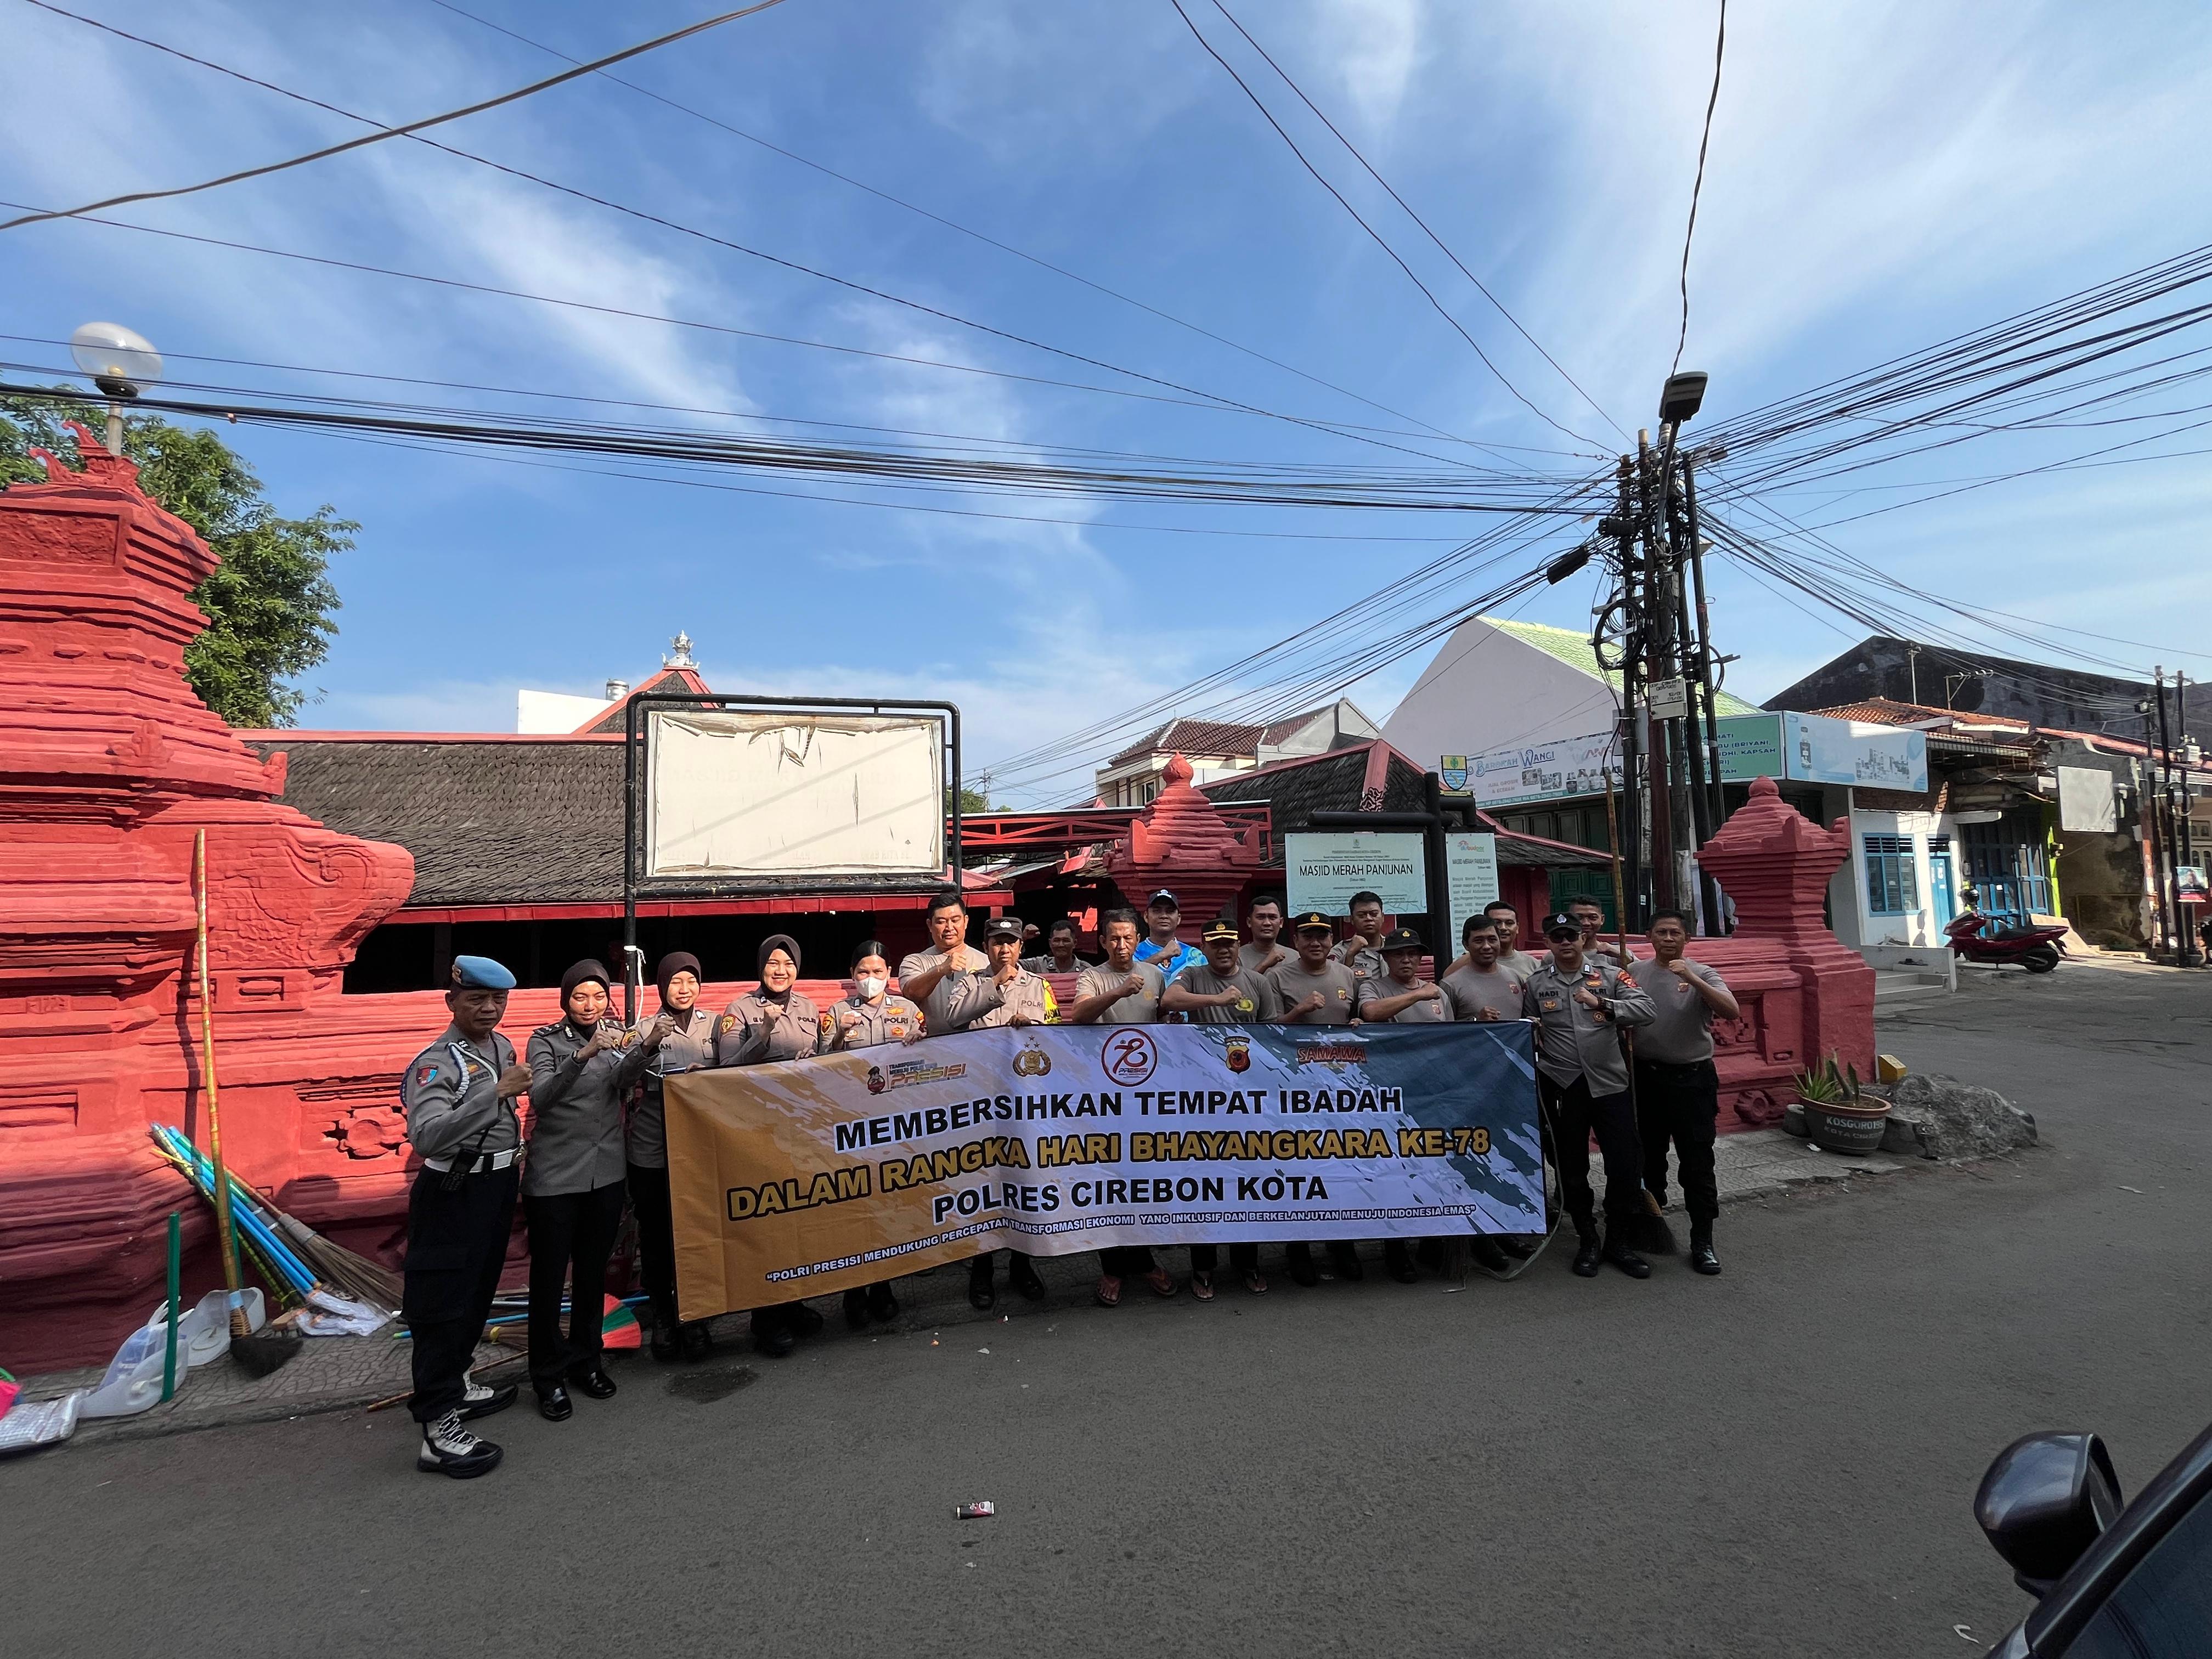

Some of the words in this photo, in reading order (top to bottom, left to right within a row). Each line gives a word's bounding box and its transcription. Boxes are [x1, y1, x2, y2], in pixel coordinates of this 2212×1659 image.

[1518, 749, 1555, 768] WANGI
[1300, 865, 1330, 877] MASJID
[1333, 865, 1364, 876] MERAH
[1367, 864, 1413, 875] PANJUNAN
[1021, 1000, 1043, 1008] POLRI
[1297, 1045, 1366, 1063] SAMAWA
[890, 1063, 966, 1086] PRESISI
[835, 1092, 1122, 1150] MEMBERSIHKAN
[1135, 1090, 1267, 1115] TEMPAT
[1280, 1088, 1402, 1114] IBADAH
[1824, 1126, 1850, 1138] KOTA
[730, 1167, 870, 1218] DALAM
[882, 1138, 1029, 1193] RANGKA
[1039, 1133, 1120, 1167] HARI
[1131, 1129, 1391, 1162] BHAYANGKARA
[1400, 1127, 1490, 1156] KE-78
[934, 1182, 1059, 1223] POLRES
[1071, 1177, 1223, 1207] CIREBON
[1238, 1176, 1329, 1200] KOTA
[814, 1255, 861, 1273] PRESISI
[864, 1235, 939, 1262] MENDUKUNG
[941, 1218, 1009, 1243] PERCEPATAN
[1010, 1219, 1084, 1234] TRANSFORMASI
[1086, 1215, 1134, 1228] EKONOMI
[1140, 1214, 1170, 1224] YANG
[1172, 1213, 1221, 1222] INKLUSIF
[1224, 1212, 1246, 1221] DAN
[1249, 1211, 1339, 1222] BERKELANJUTAN
[1341, 1209, 1385, 1220] MENUJU
[1388, 1207, 1441, 1218] INDONESIA
